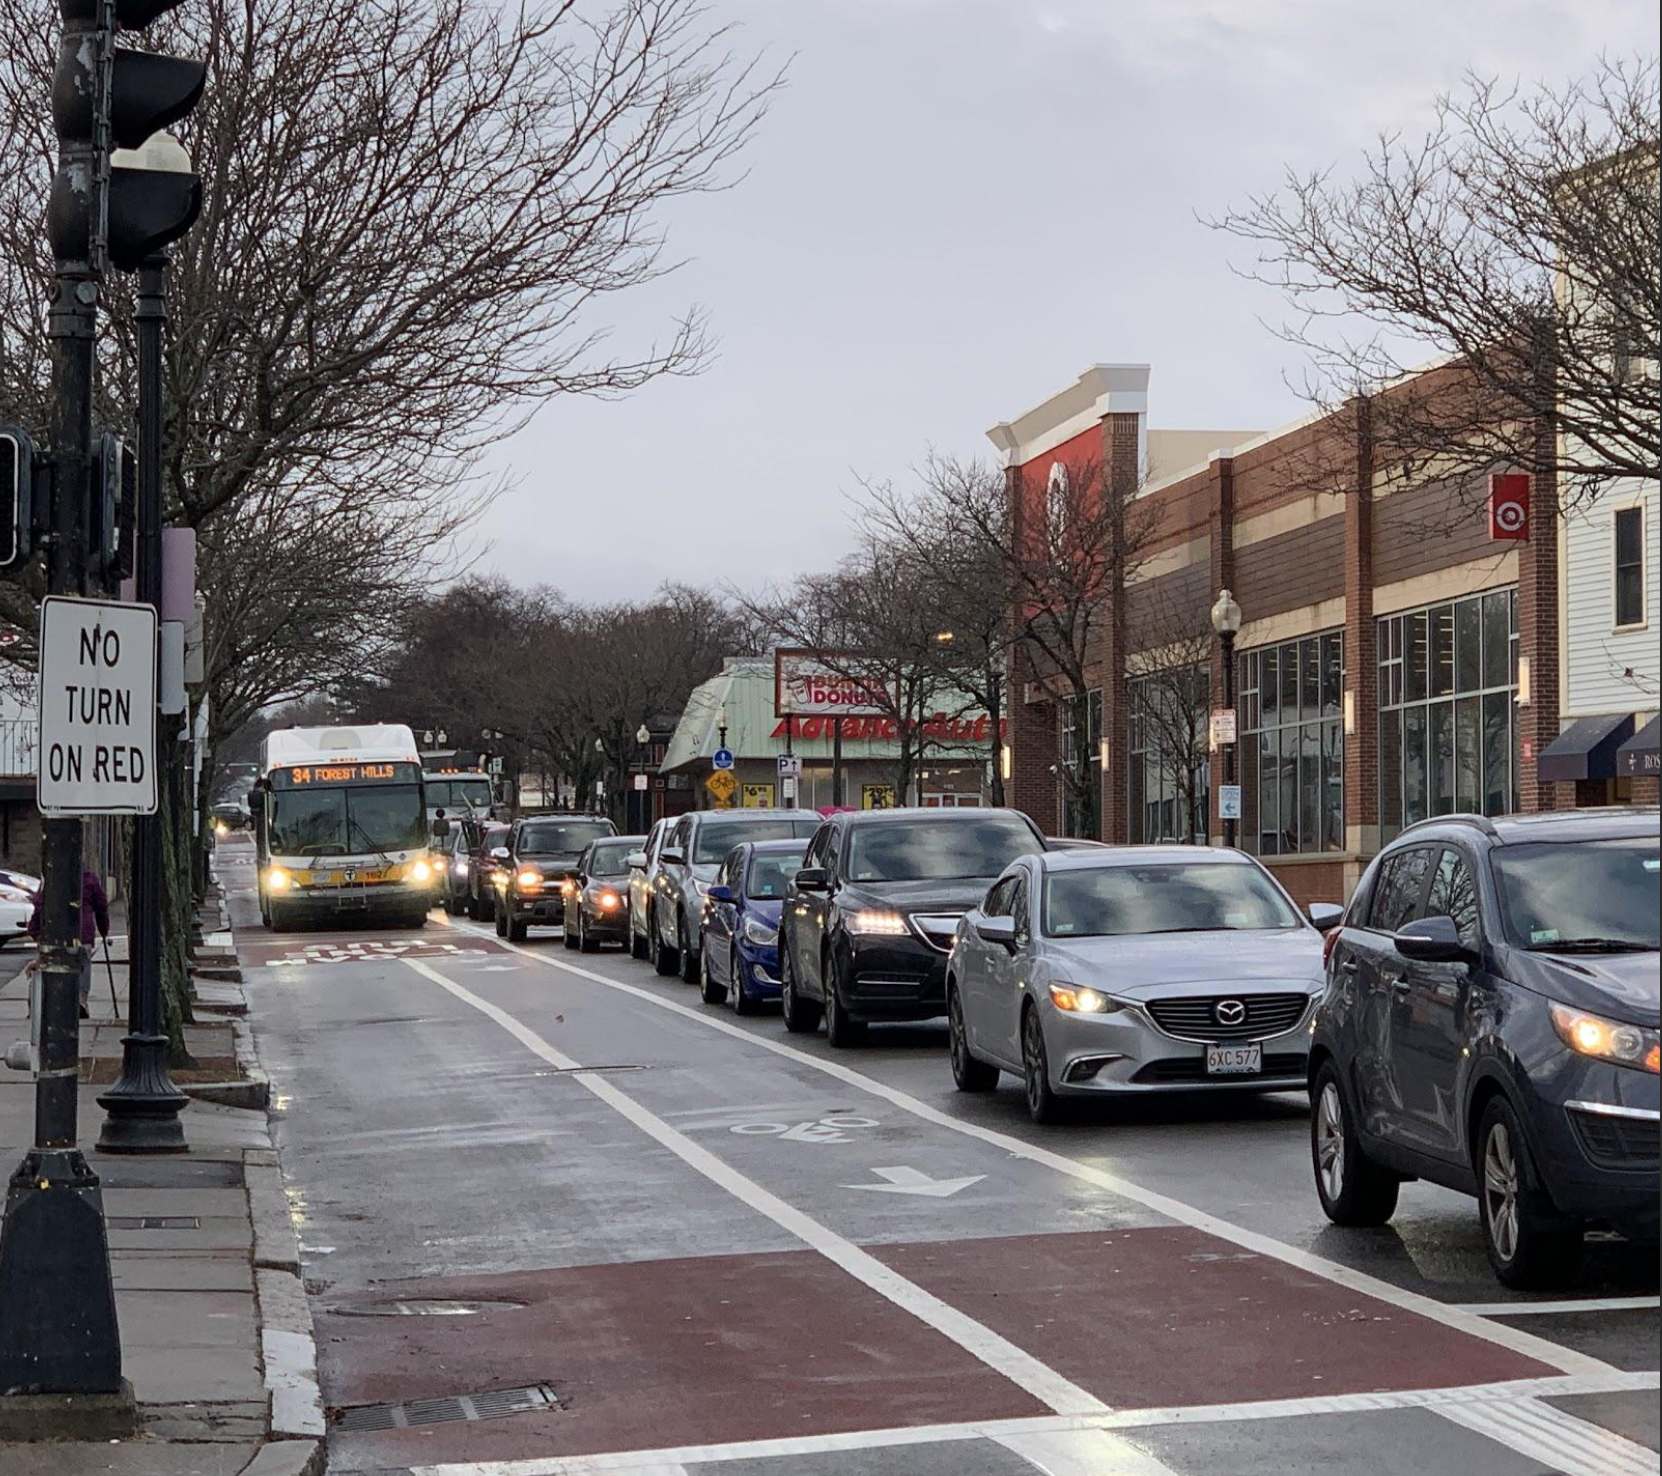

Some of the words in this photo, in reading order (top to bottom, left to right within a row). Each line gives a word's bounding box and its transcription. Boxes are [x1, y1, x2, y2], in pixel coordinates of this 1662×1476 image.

[80, 628, 119, 667] NO
[65, 685, 130, 726] TURN
[50, 743, 81, 782] ON
[95, 745, 144, 784] RED
[292, 768, 311, 783] 34
[315, 767, 357, 782] FOREST
[361, 765, 394, 778] HILLS
[1208, 1050, 1232, 1067] 6XC
[1235, 1049, 1259, 1066] 577
